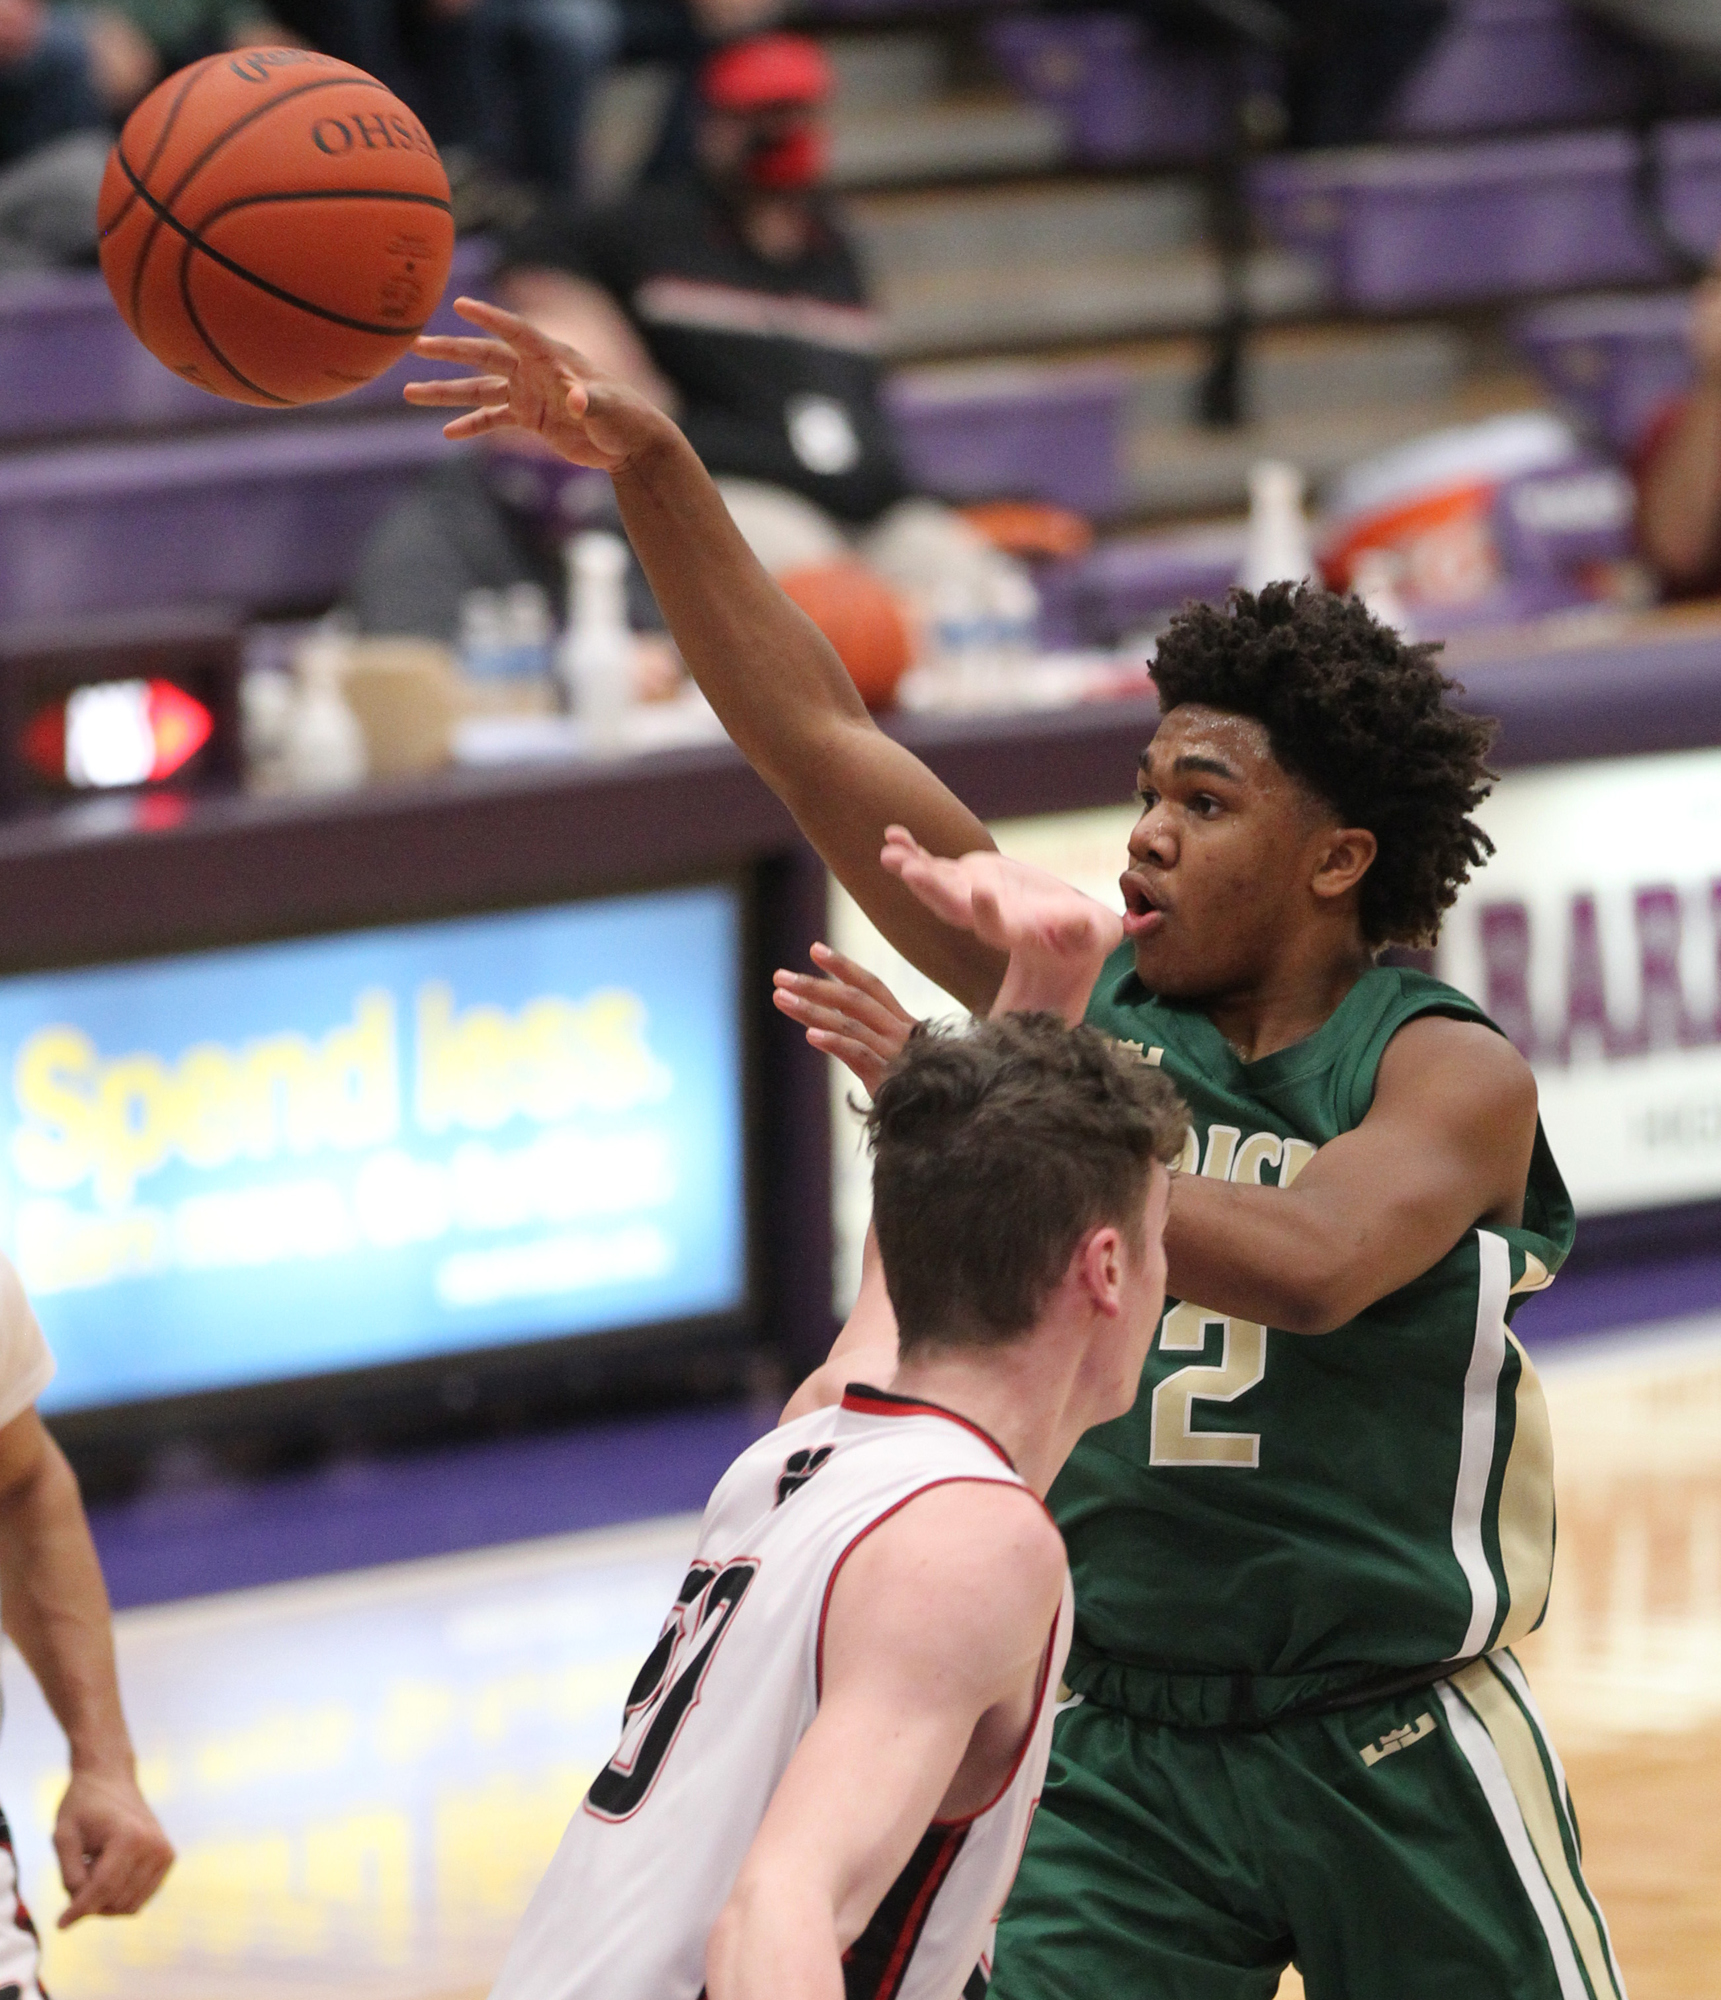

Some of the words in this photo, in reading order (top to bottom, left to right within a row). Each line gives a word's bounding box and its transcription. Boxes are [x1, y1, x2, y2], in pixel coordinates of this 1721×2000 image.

[1480, 872, 1721, 1068] BAR
[14, 990, 397, 1200] Spend
[1149, 1299, 1266, 1468] 2
